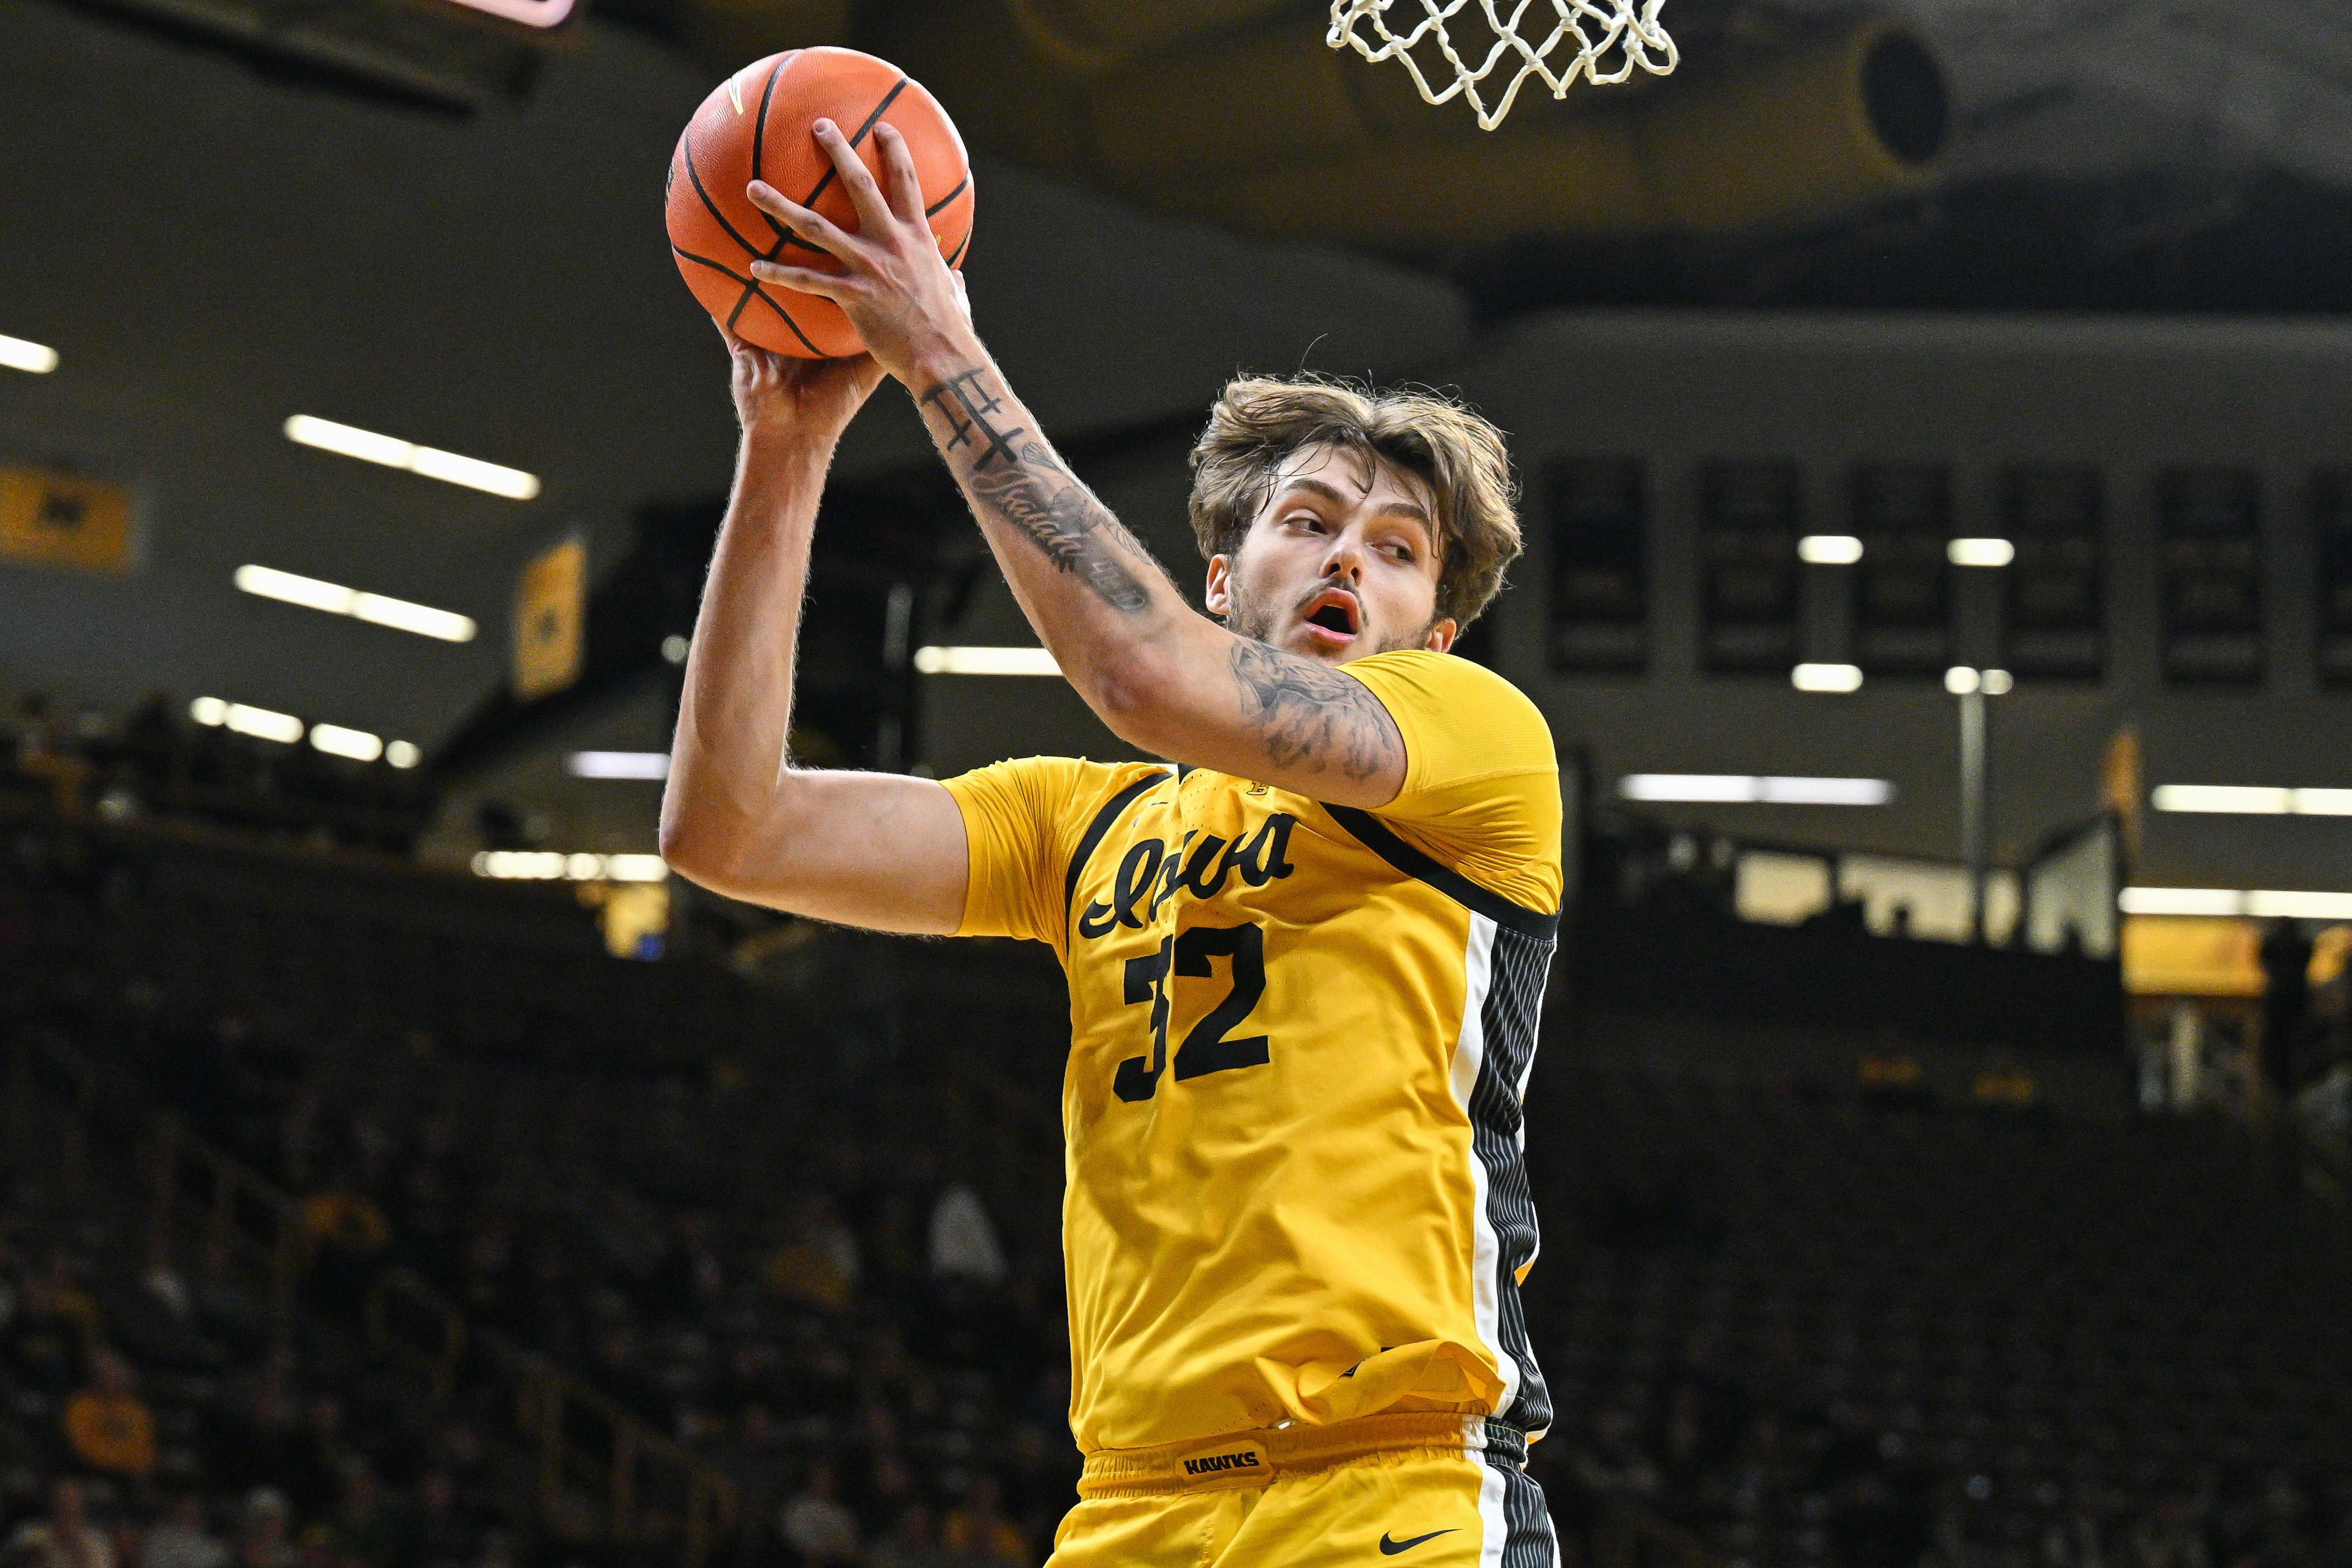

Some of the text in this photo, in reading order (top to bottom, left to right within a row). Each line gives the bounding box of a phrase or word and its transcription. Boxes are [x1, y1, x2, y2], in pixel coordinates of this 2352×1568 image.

[1078, 813, 1297, 939] Iowa
[1112, 922, 1271, 1103] 32
[1183, 1451, 1260, 1475] HAWKS
